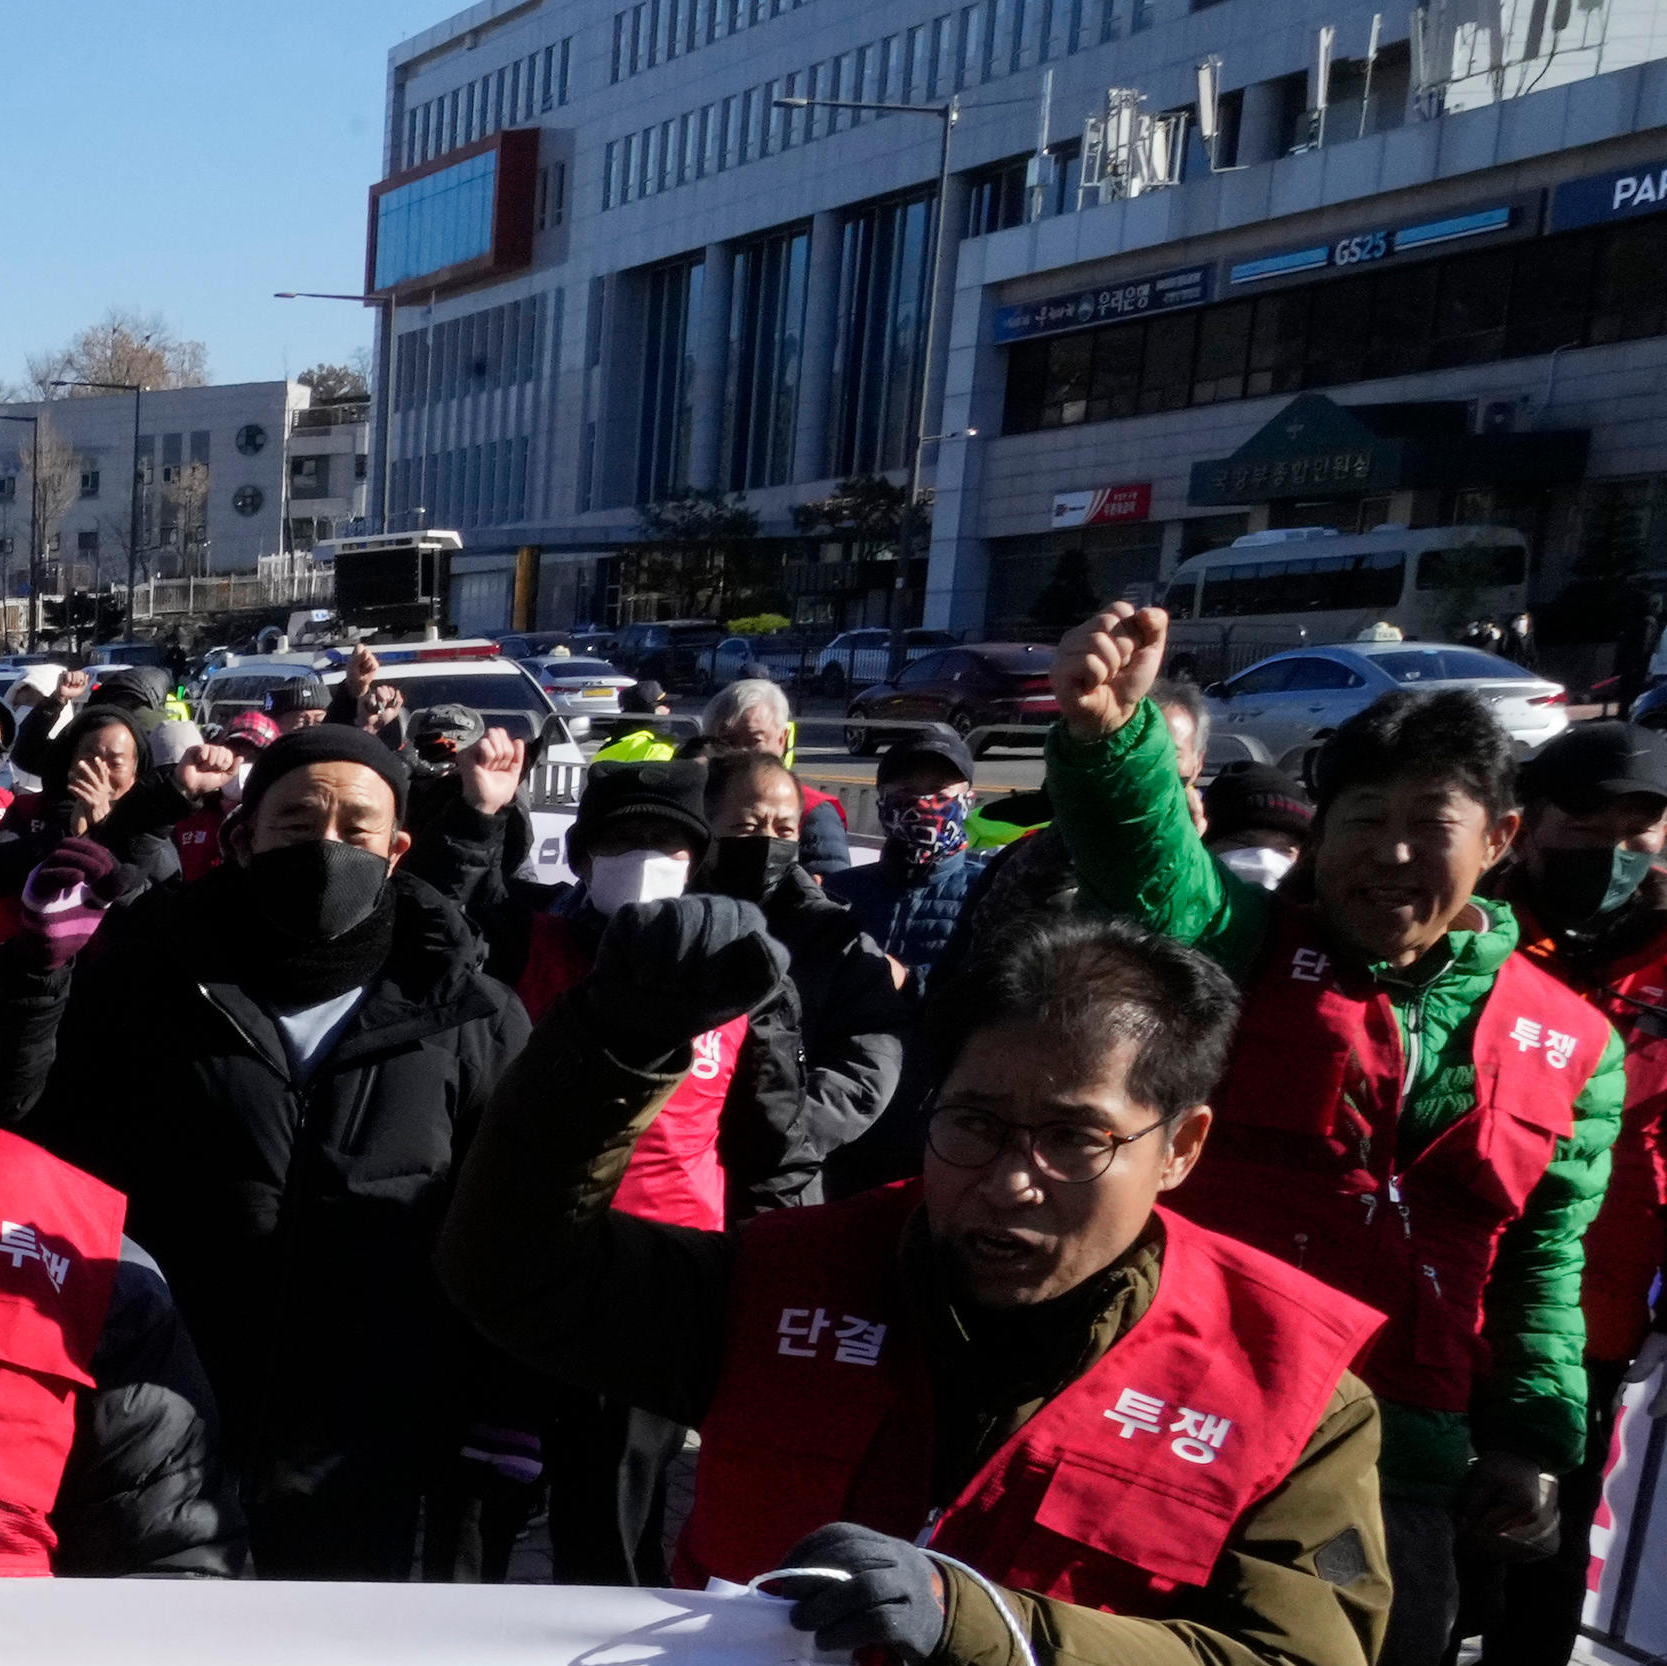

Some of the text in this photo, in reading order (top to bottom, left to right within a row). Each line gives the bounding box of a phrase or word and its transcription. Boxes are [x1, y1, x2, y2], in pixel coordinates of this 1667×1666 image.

[1334, 231, 1387, 267] GS25
[1291, 948, 1333, 982] 단
[1510, 1017, 1575, 1069] 투쟁
[778, 1307, 888, 1367] 단결
[1103, 1387, 1230, 1464] 투쟁
